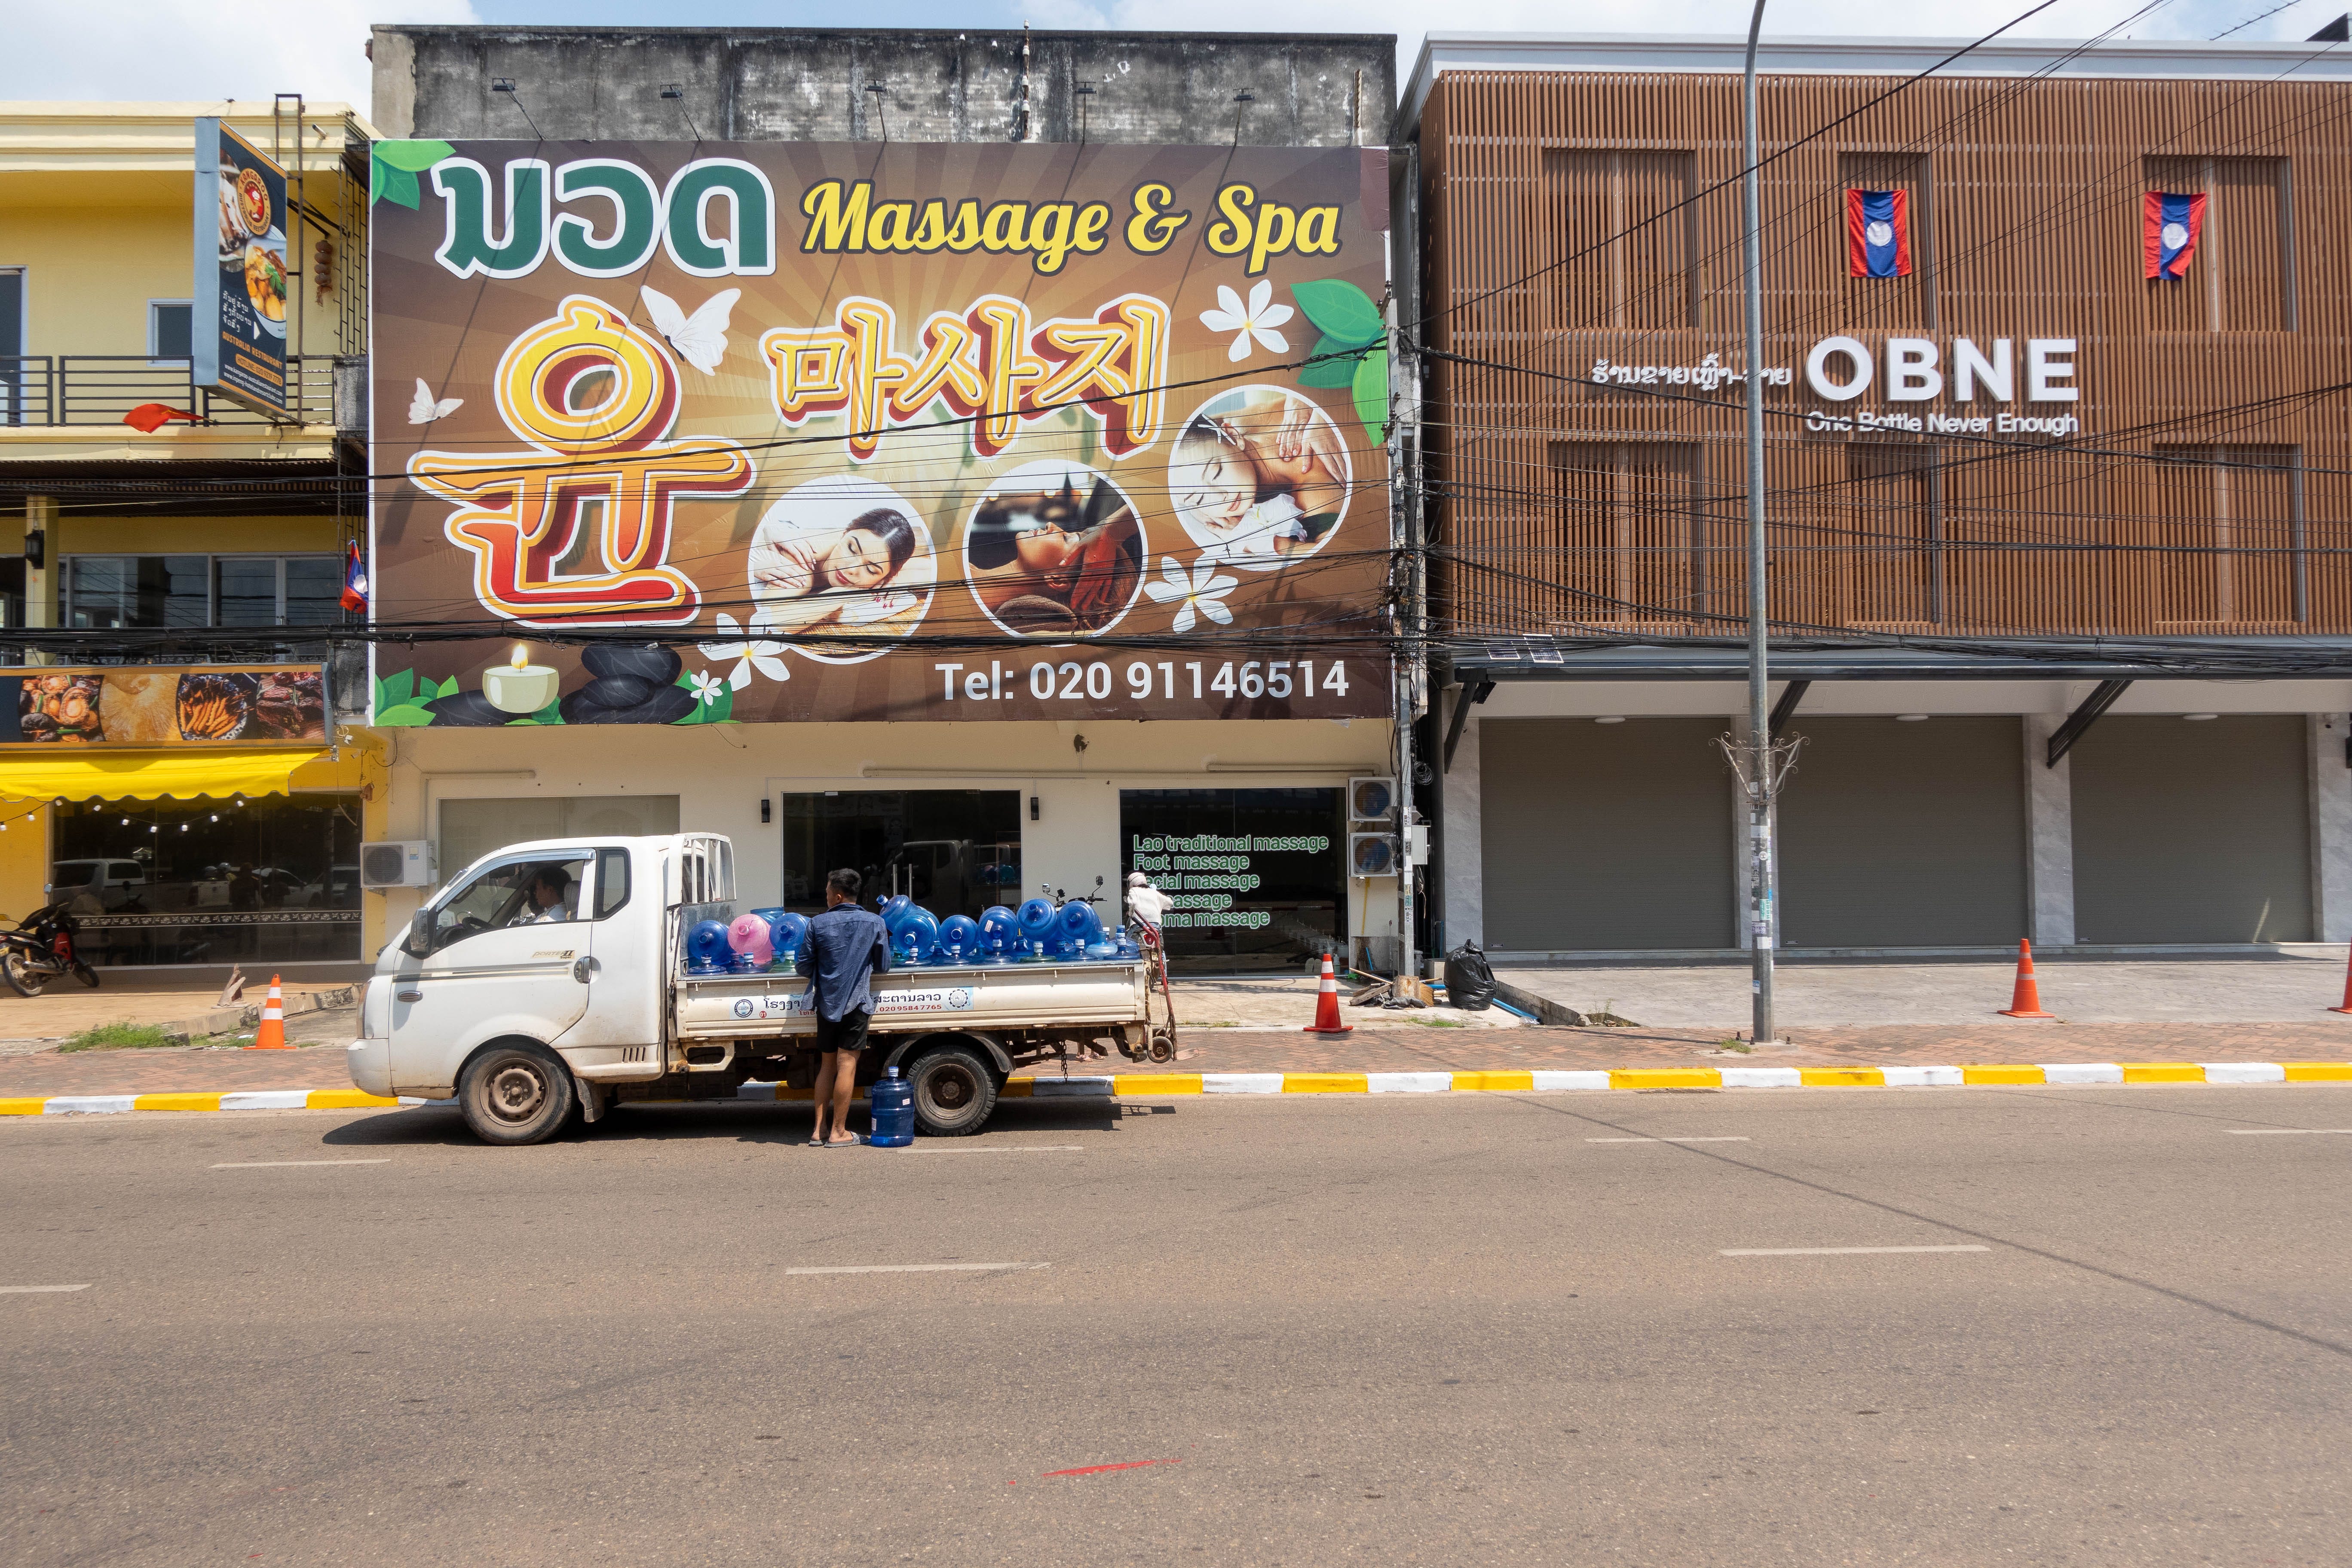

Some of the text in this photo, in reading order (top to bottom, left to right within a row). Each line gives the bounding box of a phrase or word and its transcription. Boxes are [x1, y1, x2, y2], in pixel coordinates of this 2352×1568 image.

[240, 171, 268, 201] KANGAROO
[431, 157, 776, 279] ນວດ
[801, 178, 1342, 277] Massage & Spa
[222, 331, 282, 369] AUSTRALIA RESTAURANT
[1806, 336, 2079, 403] OBNE
[1807, 410, 2079, 437] One Bottle Never Enough
[407, 293, 1172, 629] 윤 마사지
[935, 660, 1350, 700] Tel: 020 91146514
[1133, 834, 1329, 854] Lao traditional massage
[1133, 853, 1250, 873] Foot massage
[1142, 873, 1260, 892] acial massage
[1194, 911, 1270, 929] massage
